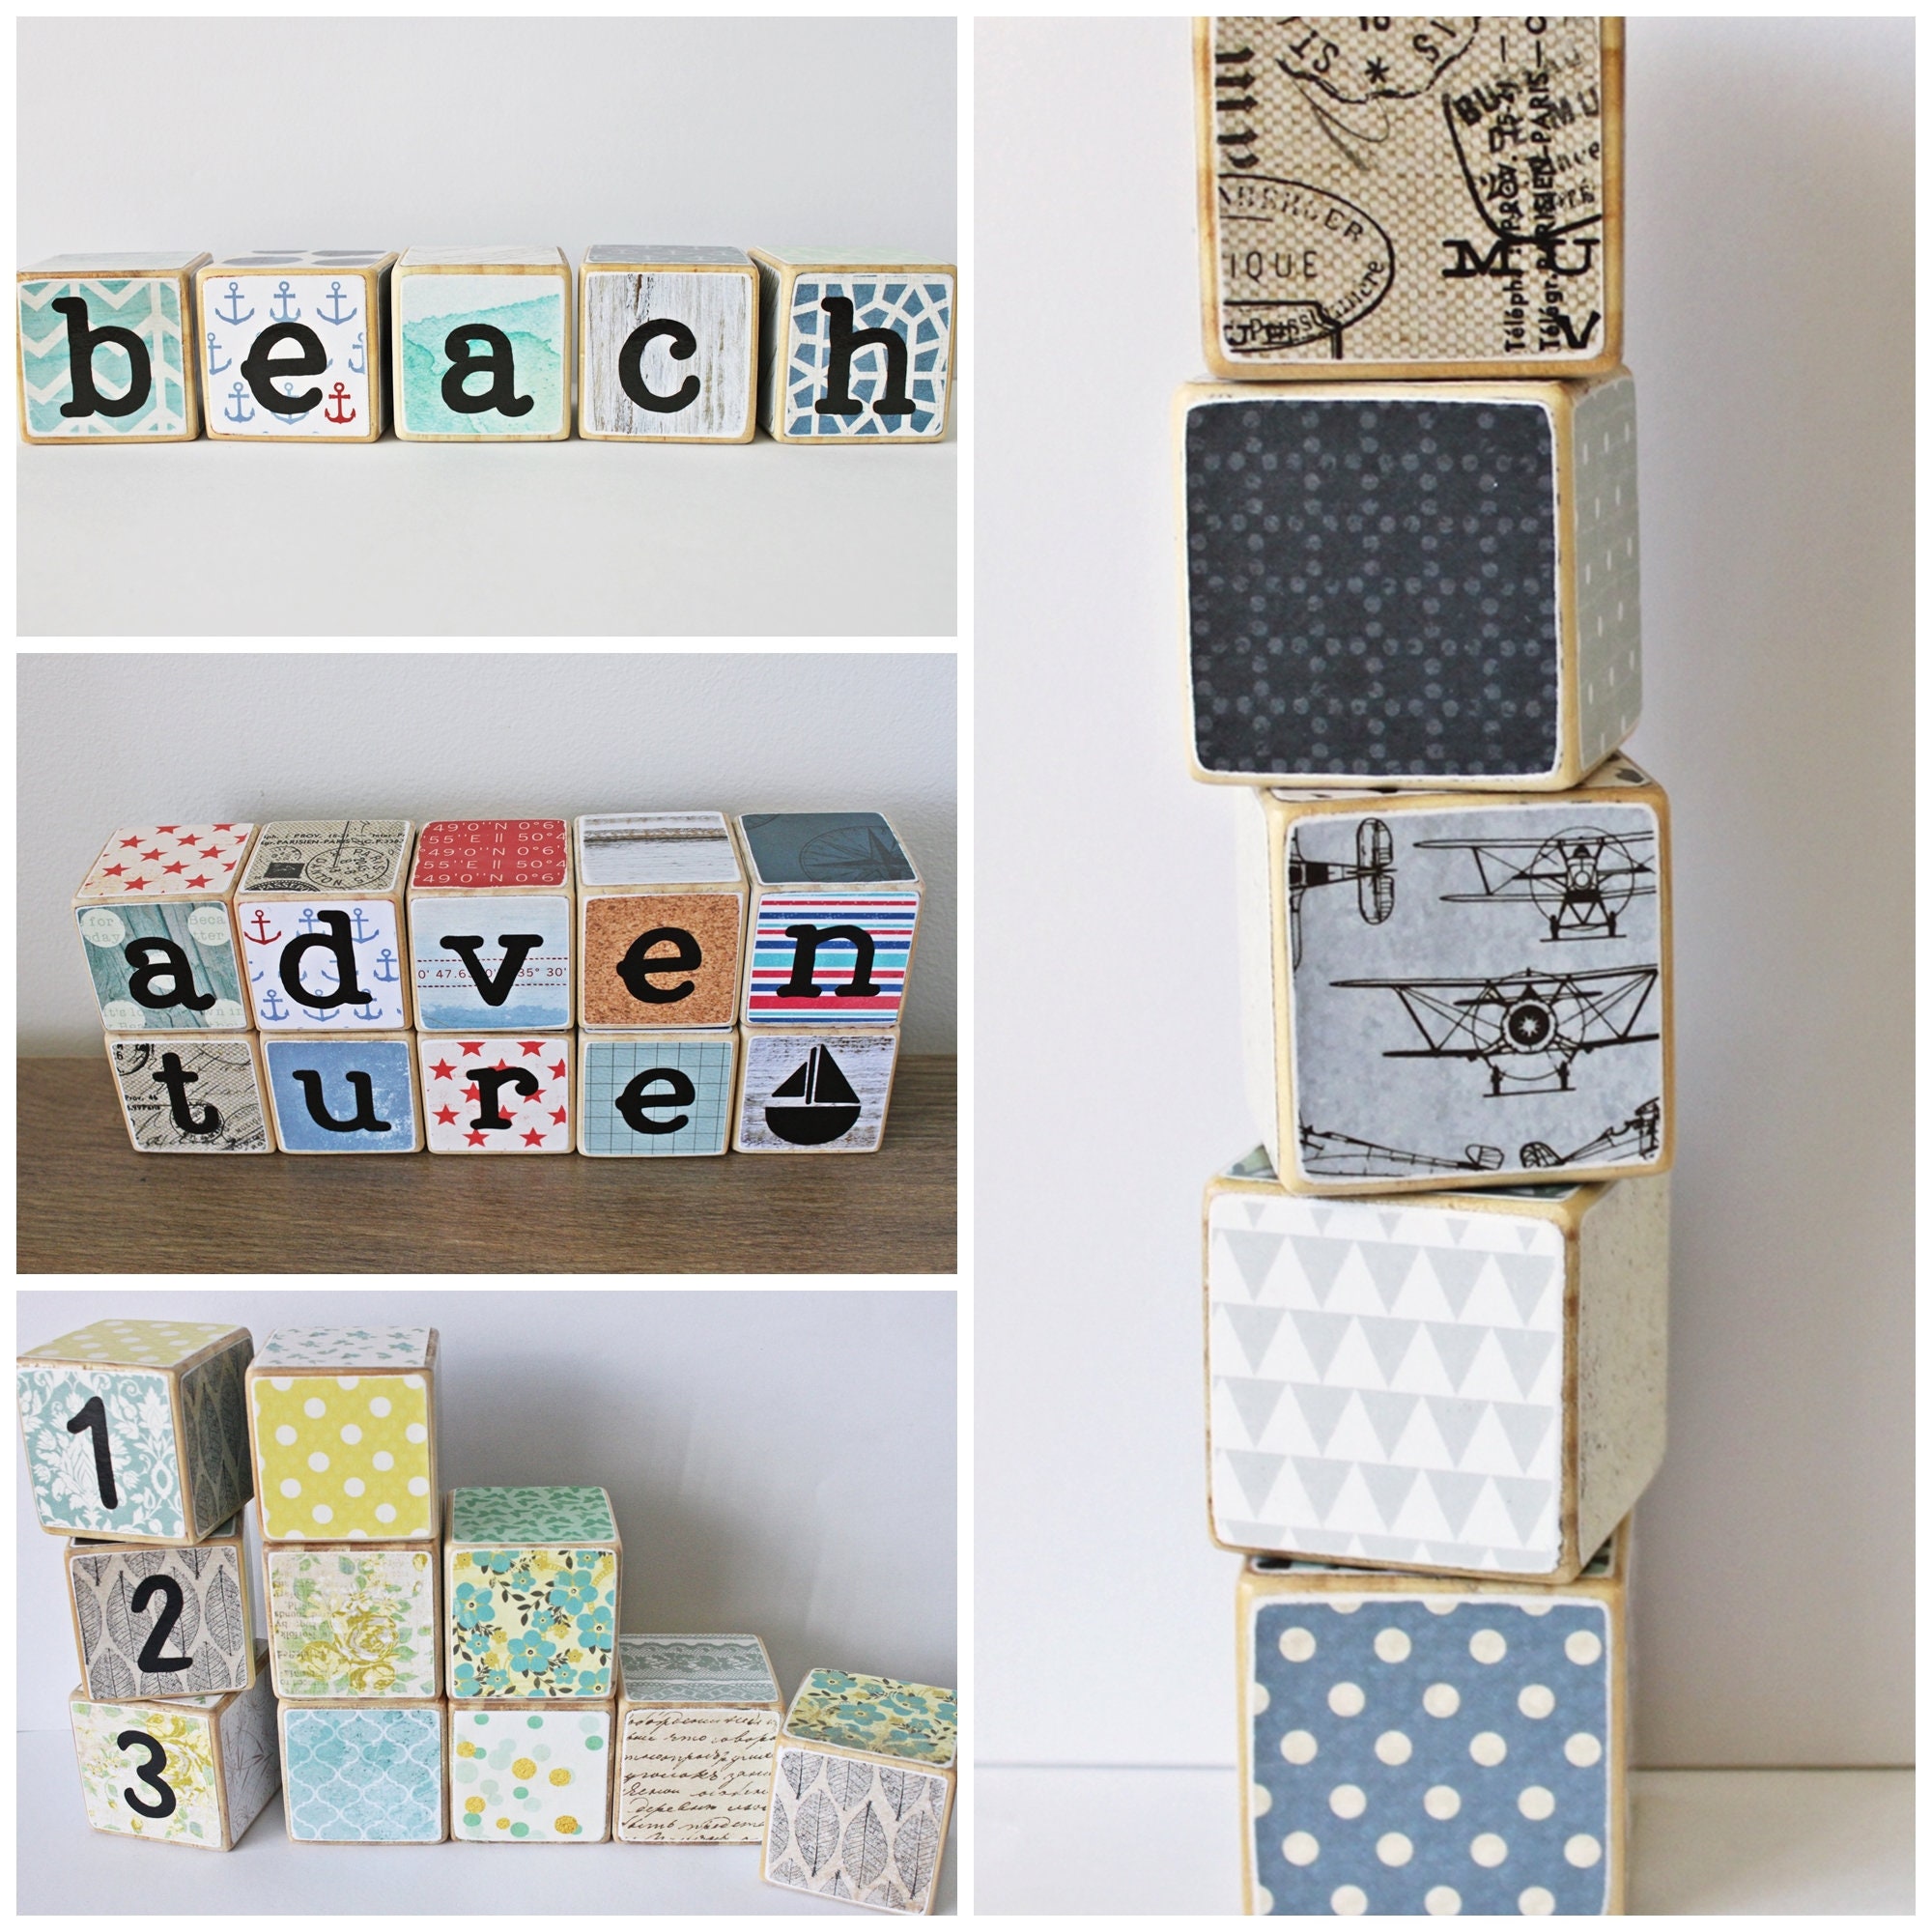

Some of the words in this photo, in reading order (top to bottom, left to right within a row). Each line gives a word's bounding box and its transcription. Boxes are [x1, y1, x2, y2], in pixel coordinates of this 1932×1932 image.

[67, 1396, 119, 1510] 1
[131, 1574, 193, 1673] 2
[117, 1730, 177, 1819] 3
